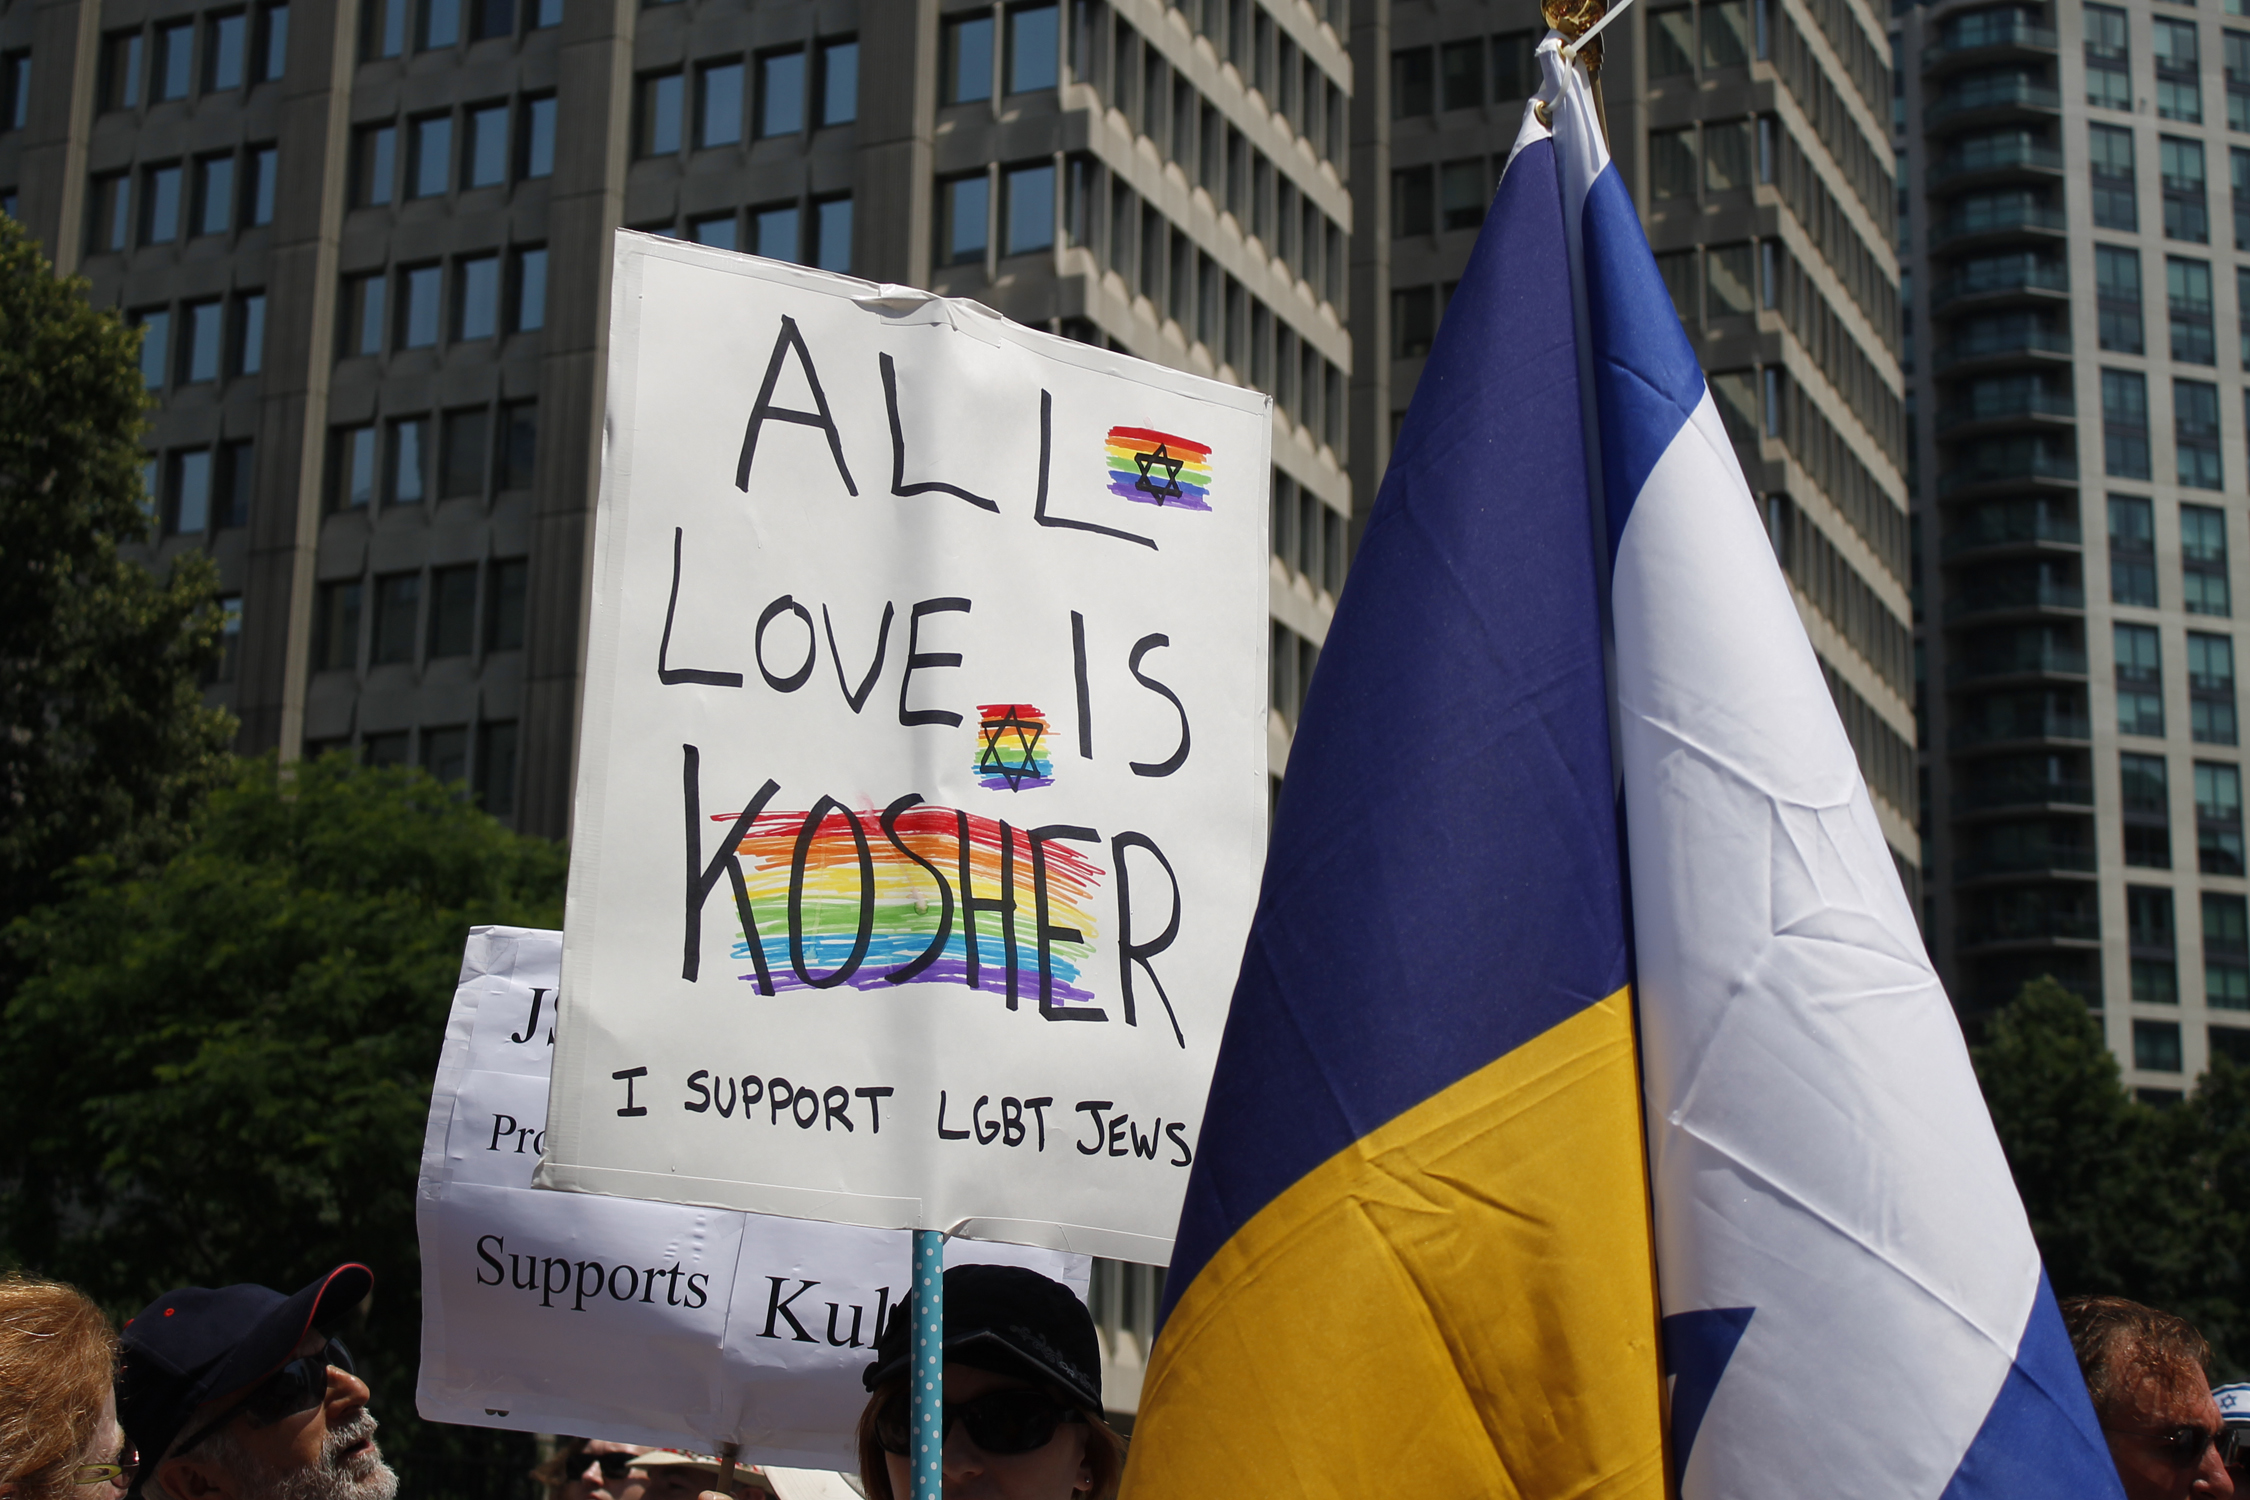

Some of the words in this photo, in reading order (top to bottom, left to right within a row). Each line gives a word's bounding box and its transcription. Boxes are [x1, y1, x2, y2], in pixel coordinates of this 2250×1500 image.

[735, 314, 1158, 551] ALL
[658, 526, 972, 728] LOVE
[1070, 610, 1191, 778] IS
[682, 743, 1186, 1049] KOSHER
[511, 987, 558, 1046] J
[611, 1066, 648, 1118] I
[684, 1069, 895, 1135] SUPPORT
[937, 1090, 1054, 1153] LGBT
[1075, 1100, 1193, 1168] JEWS
[476, 1234, 710, 1314] Supports
